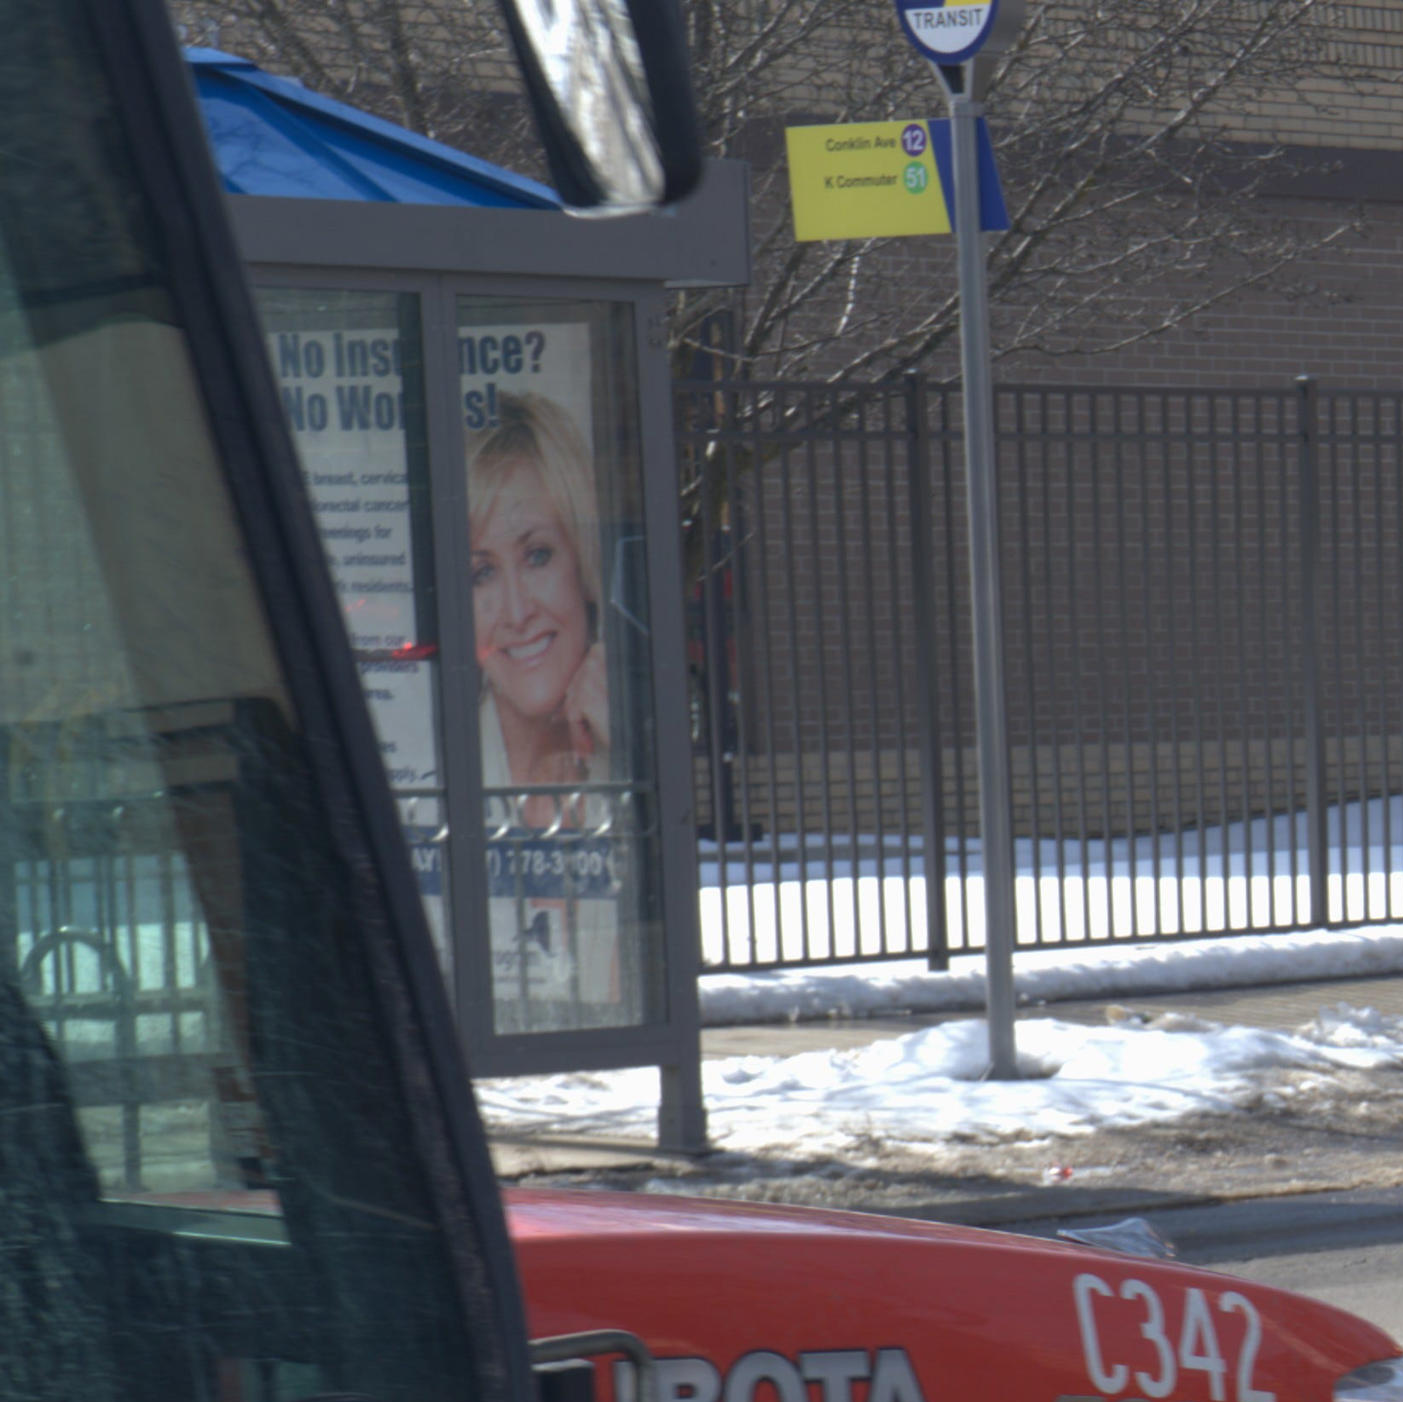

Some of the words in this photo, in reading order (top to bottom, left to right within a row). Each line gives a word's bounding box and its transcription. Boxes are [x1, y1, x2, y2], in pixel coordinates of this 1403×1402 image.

[913, 8, 984, 29] TRANSIT
[826, 137, 871, 152] Conklin
[874, 135, 896, 149] Ave
[904, 130, 923, 151] 12
[824, 176, 834, 189] K
[836, 173, 897, 188] Commuter
[907, 167, 926, 188] 51
[279, 333, 325, 379] No
[284, 386, 329, 432] No
